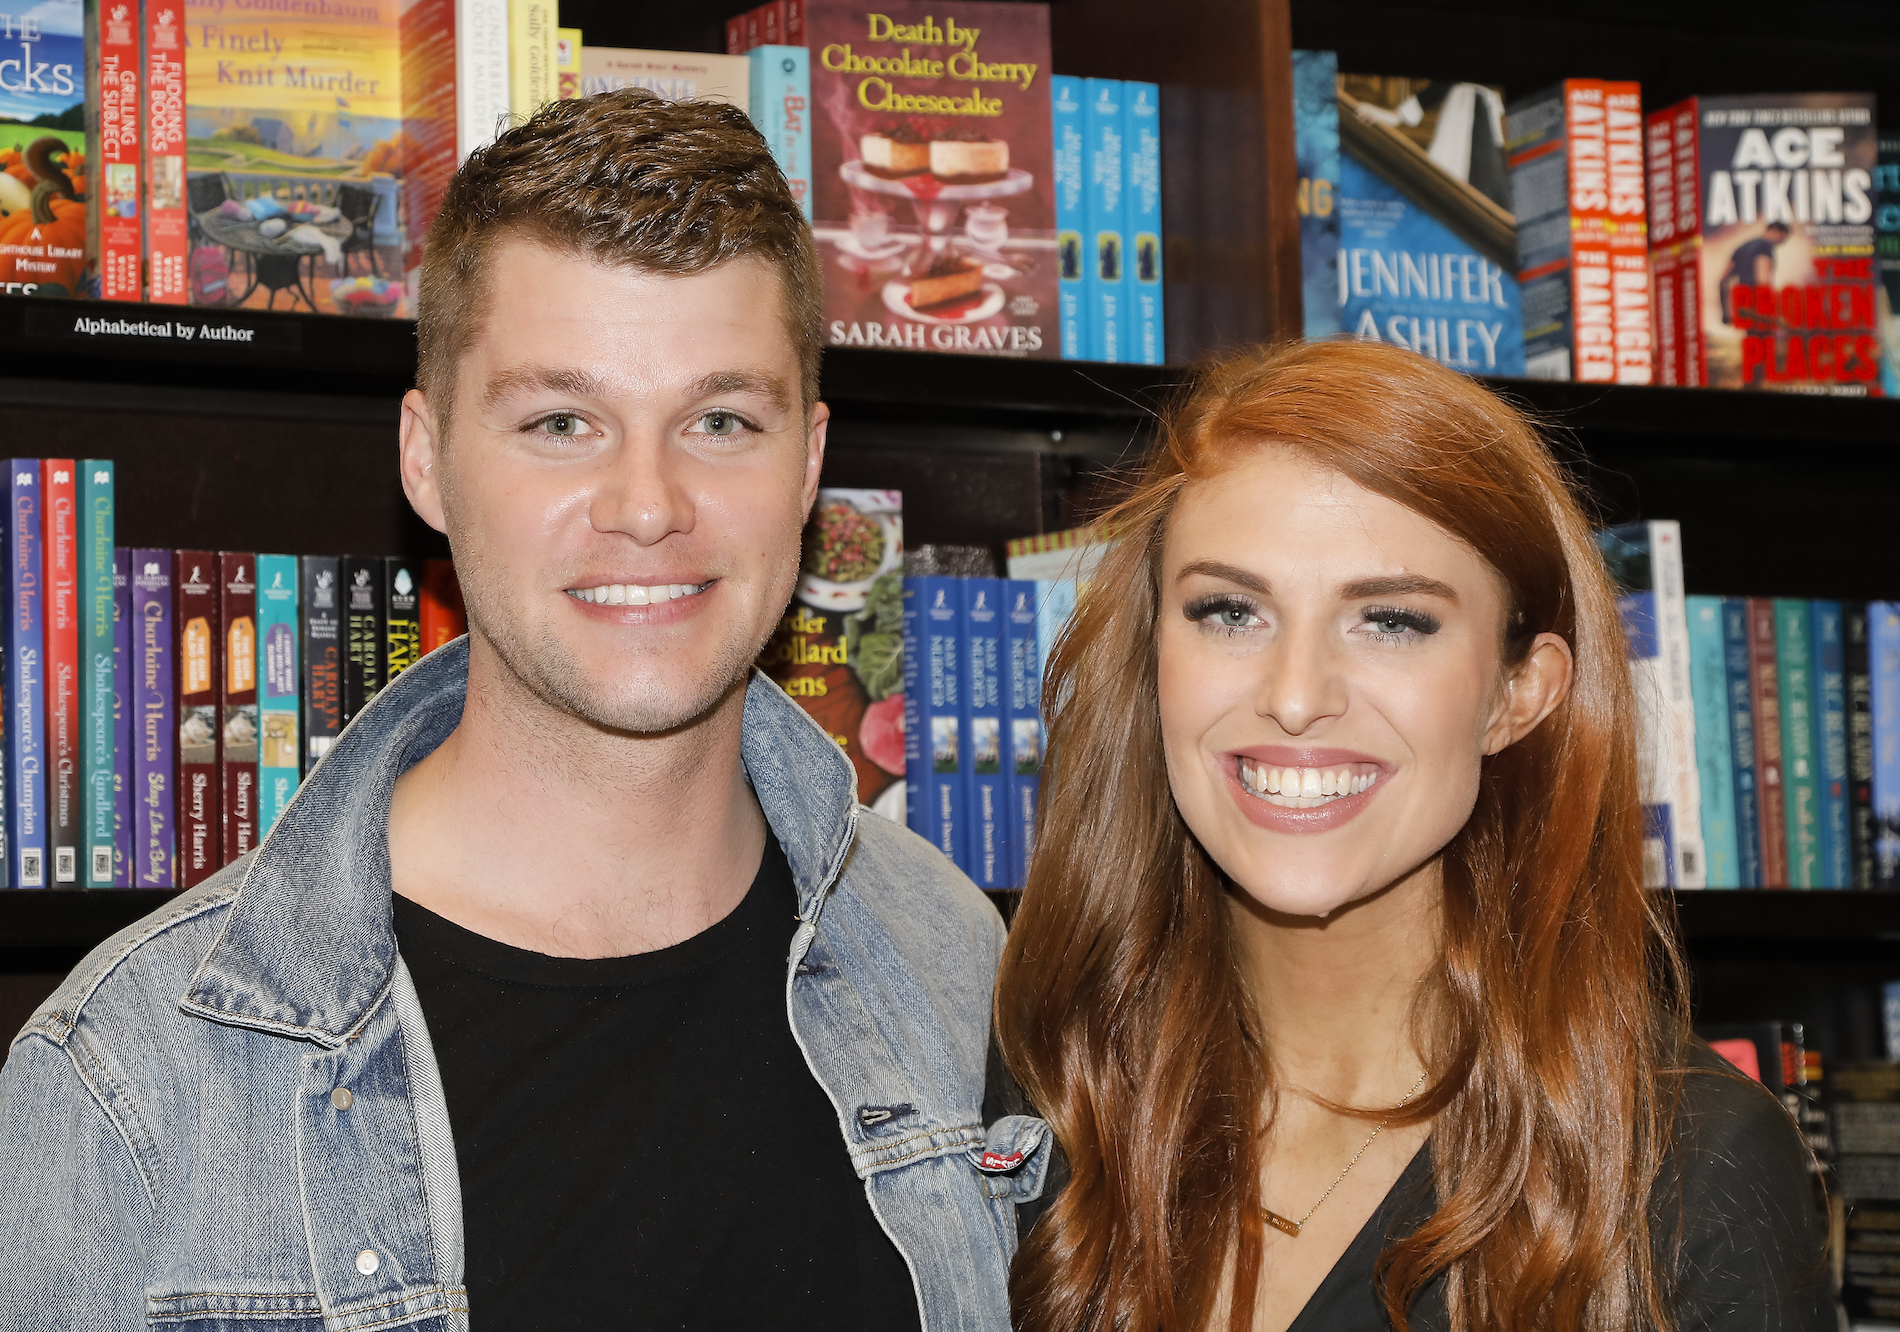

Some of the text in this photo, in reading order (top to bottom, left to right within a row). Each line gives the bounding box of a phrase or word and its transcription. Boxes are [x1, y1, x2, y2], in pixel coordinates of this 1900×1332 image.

[0, 14, 42, 41] HE
[202, 25, 284, 62] Finely
[527, 4, 541, 39] Sally
[868, 13, 981, 53] Death by
[217, 60, 380, 94] Knit Murder
[821, 43, 1038, 90] Chocolate Cherry
[103, 53, 121, 160] THE SUBJECT
[120, 70, 137, 146] GRILLING
[150, 52, 168, 152] THE BOOKS
[165, 61, 183, 143] FUDGING
[857, 76, 1003, 117] Cheesecake
[1571, 104, 1608, 211] ATKINS
[1607, 109, 1645, 215] ATKINS
[1732, 126, 1845, 169] ACE
[1706, 168, 1873, 225] ATKINS
[31, 228, 42, 241] A
[1337, 247, 1509, 309] JENNIFER
[1813, 258, 1875, 279] THE
[74, 317, 254, 342] Alphabetical by Author
[830, 320, 926, 347] SARAH
[932, 323, 1043, 351] GRAVES
[1577, 267, 1614, 381] RANGER
[1613, 271, 1652, 385] RANGER
[1731, 285, 1875, 330] BROKEN
[1742, 335, 1878, 383] PLACES
[17, 496, 36, 631] Charlaine Harris
[55, 497, 73, 629] Charlaine Harris
[94, 497, 111, 637] Charlaine Harris
[350, 615, 363, 664] HART
[388, 619, 410, 675] HAR
[409, 621, 420, 665] CARO
[144, 601, 165, 761] Charlaine Harris
[312, 664, 325, 711] HART
[325, 647, 339, 729] CAROLYN
[783, 676, 828, 697] ens
[931, 635, 945, 707] MURDER
[972, 636, 985, 708] MURDER
[18, 646, 39, 835] Shakespeare's Champion
[54, 662, 73, 827] Shakespeare's Christmas
[91, 653, 112, 838] Shakespeare's Landlord
[144, 772, 166, 808] Sleep
[234, 771, 252, 820] Sherry
[189, 772, 207, 870] Sherry Harris
[143, 847, 166, 884] Baby
